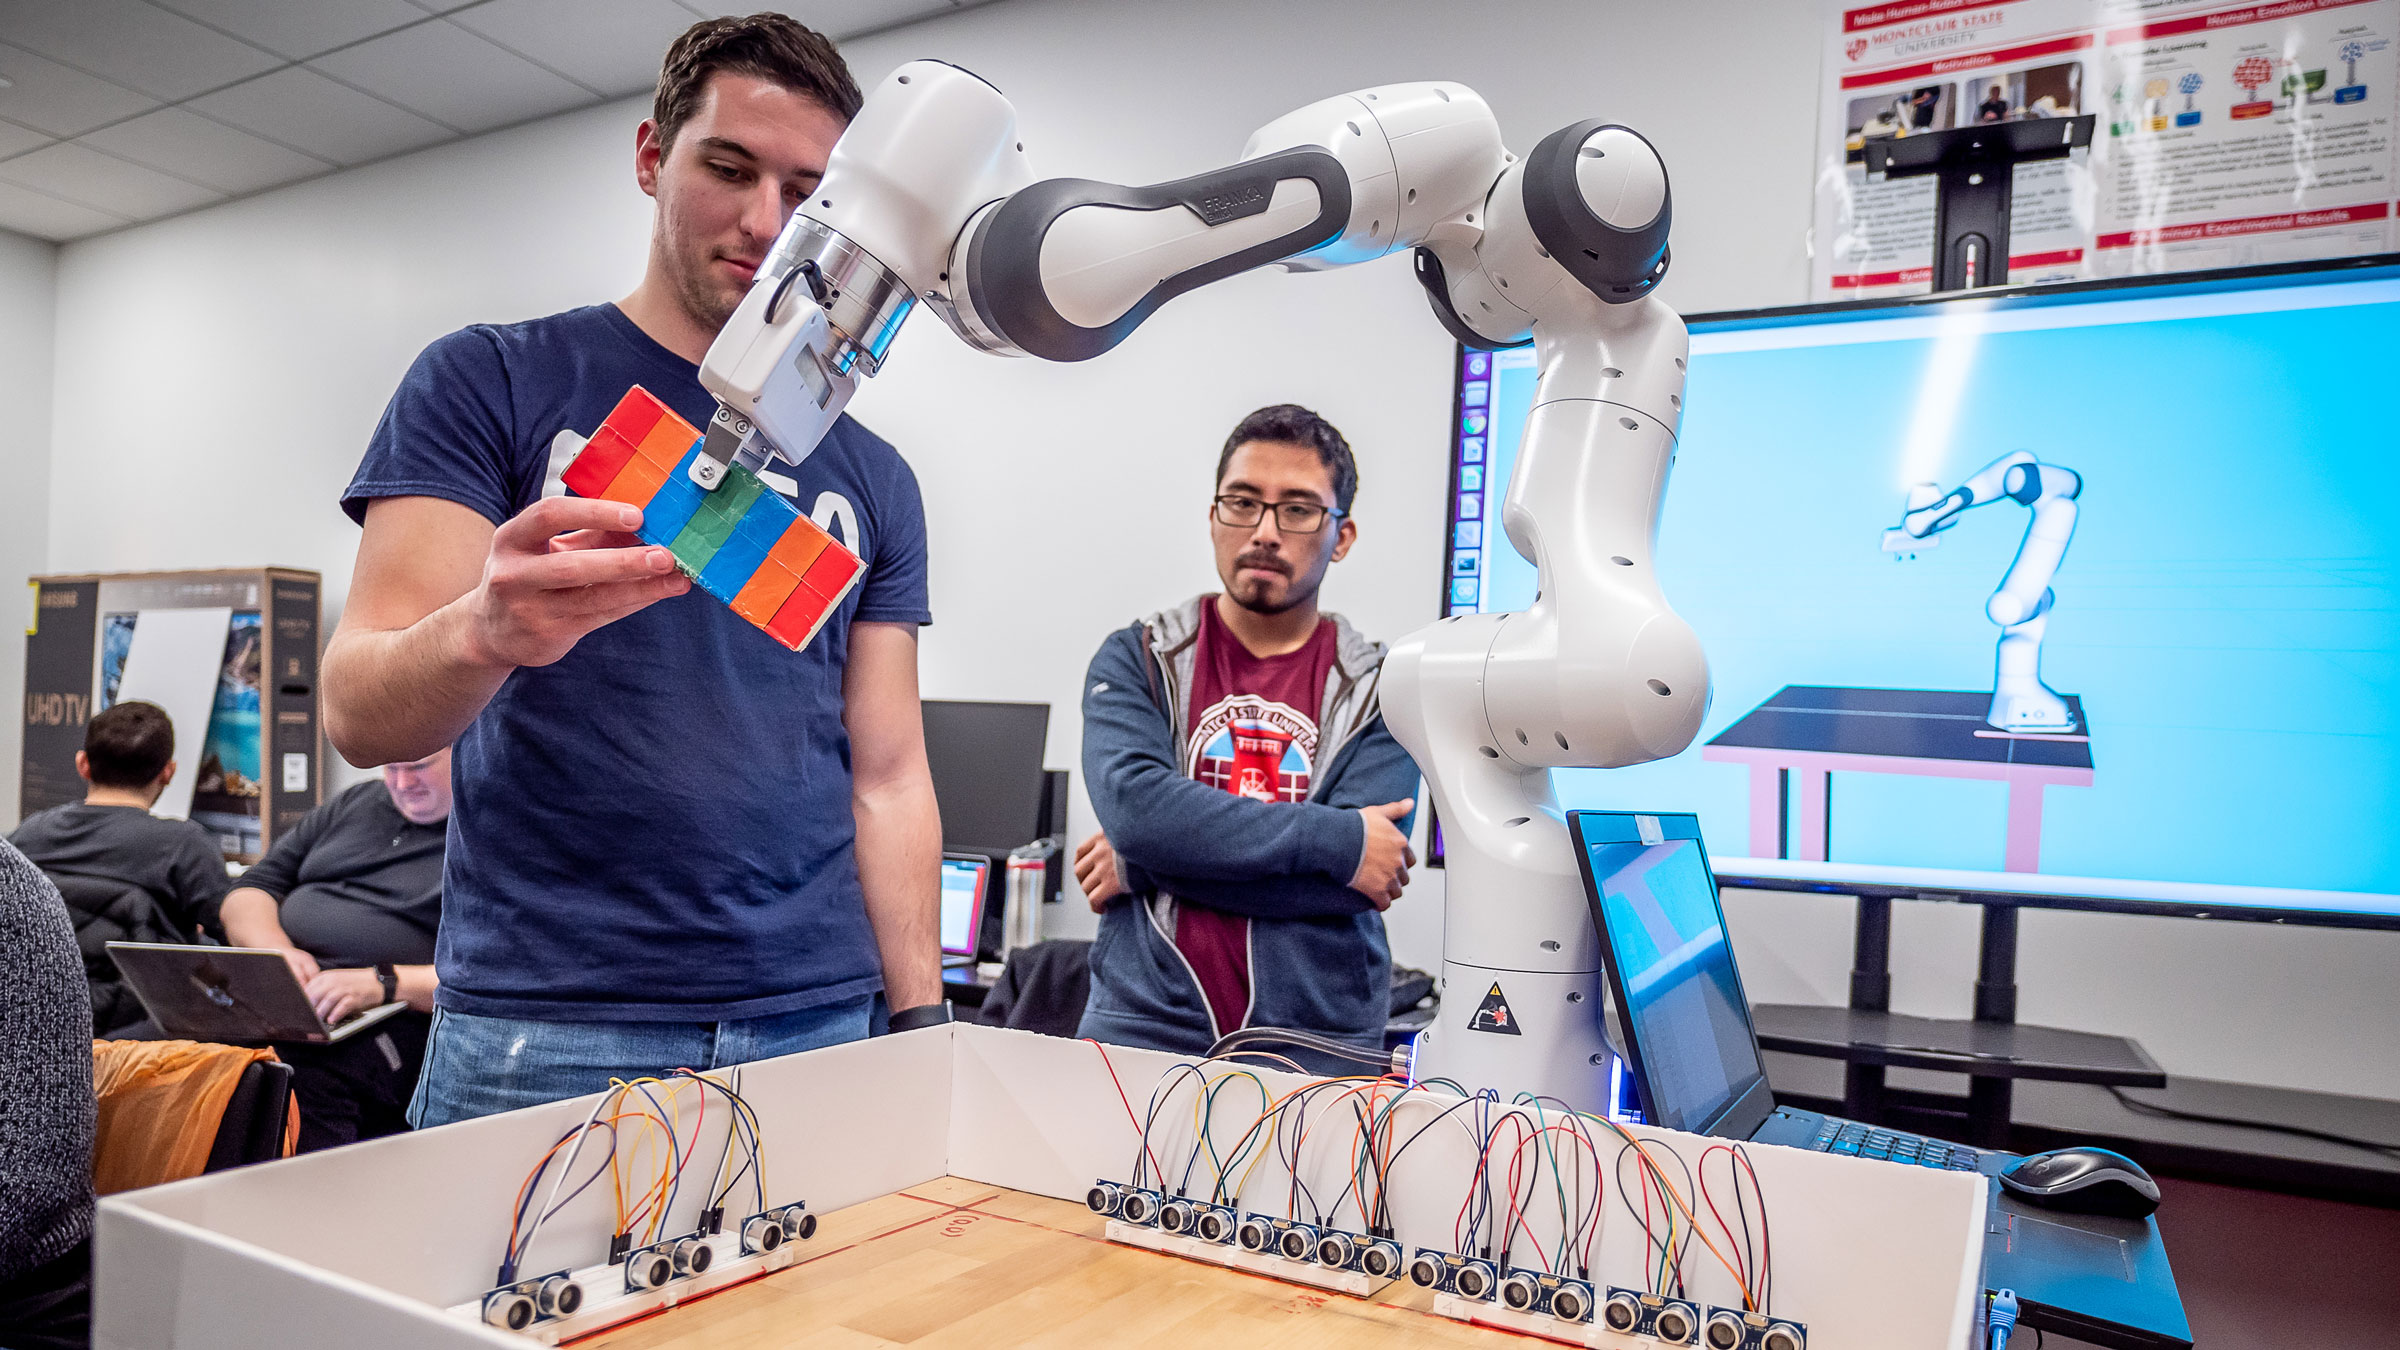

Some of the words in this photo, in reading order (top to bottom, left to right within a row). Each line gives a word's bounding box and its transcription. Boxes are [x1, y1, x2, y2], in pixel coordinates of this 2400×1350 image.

[1871, 19, 1957, 45] MONTCLAIR
[1962, 10, 2004, 28] STATE
[2206, 11, 2254, 27] Human
[1895, 31, 1977, 56] UNIVERSITY
[1932, 55, 1994, 73] Motivation
[2205, 214, 2293, 234] Experimental
[2296, 209, 2349, 226] Results
